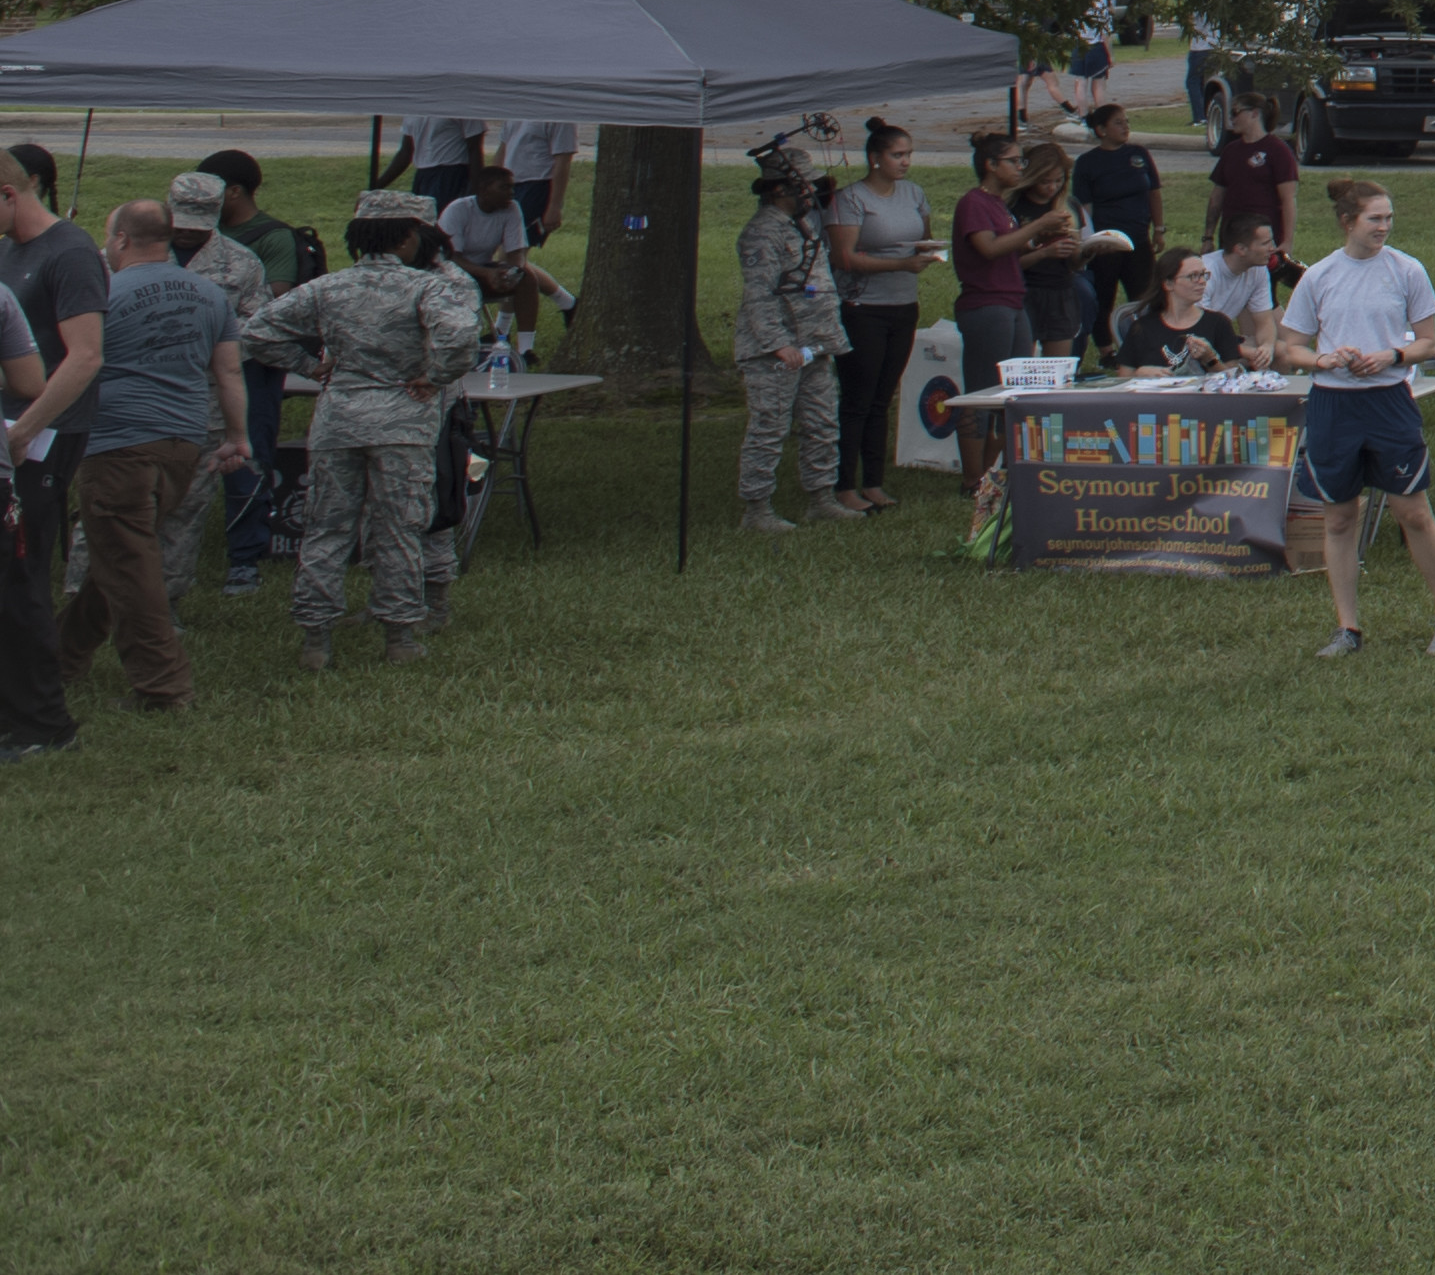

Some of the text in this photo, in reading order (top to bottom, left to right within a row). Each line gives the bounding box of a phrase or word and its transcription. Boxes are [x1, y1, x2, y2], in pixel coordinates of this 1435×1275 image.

[134, 280, 199, 300] RED ROCK
[1037, 469, 1270, 500] Seymour Johnson
[1074, 507, 1231, 535] Homeschool
[1046, 536, 1251, 557] seymourjohnsonhomeschool.com
